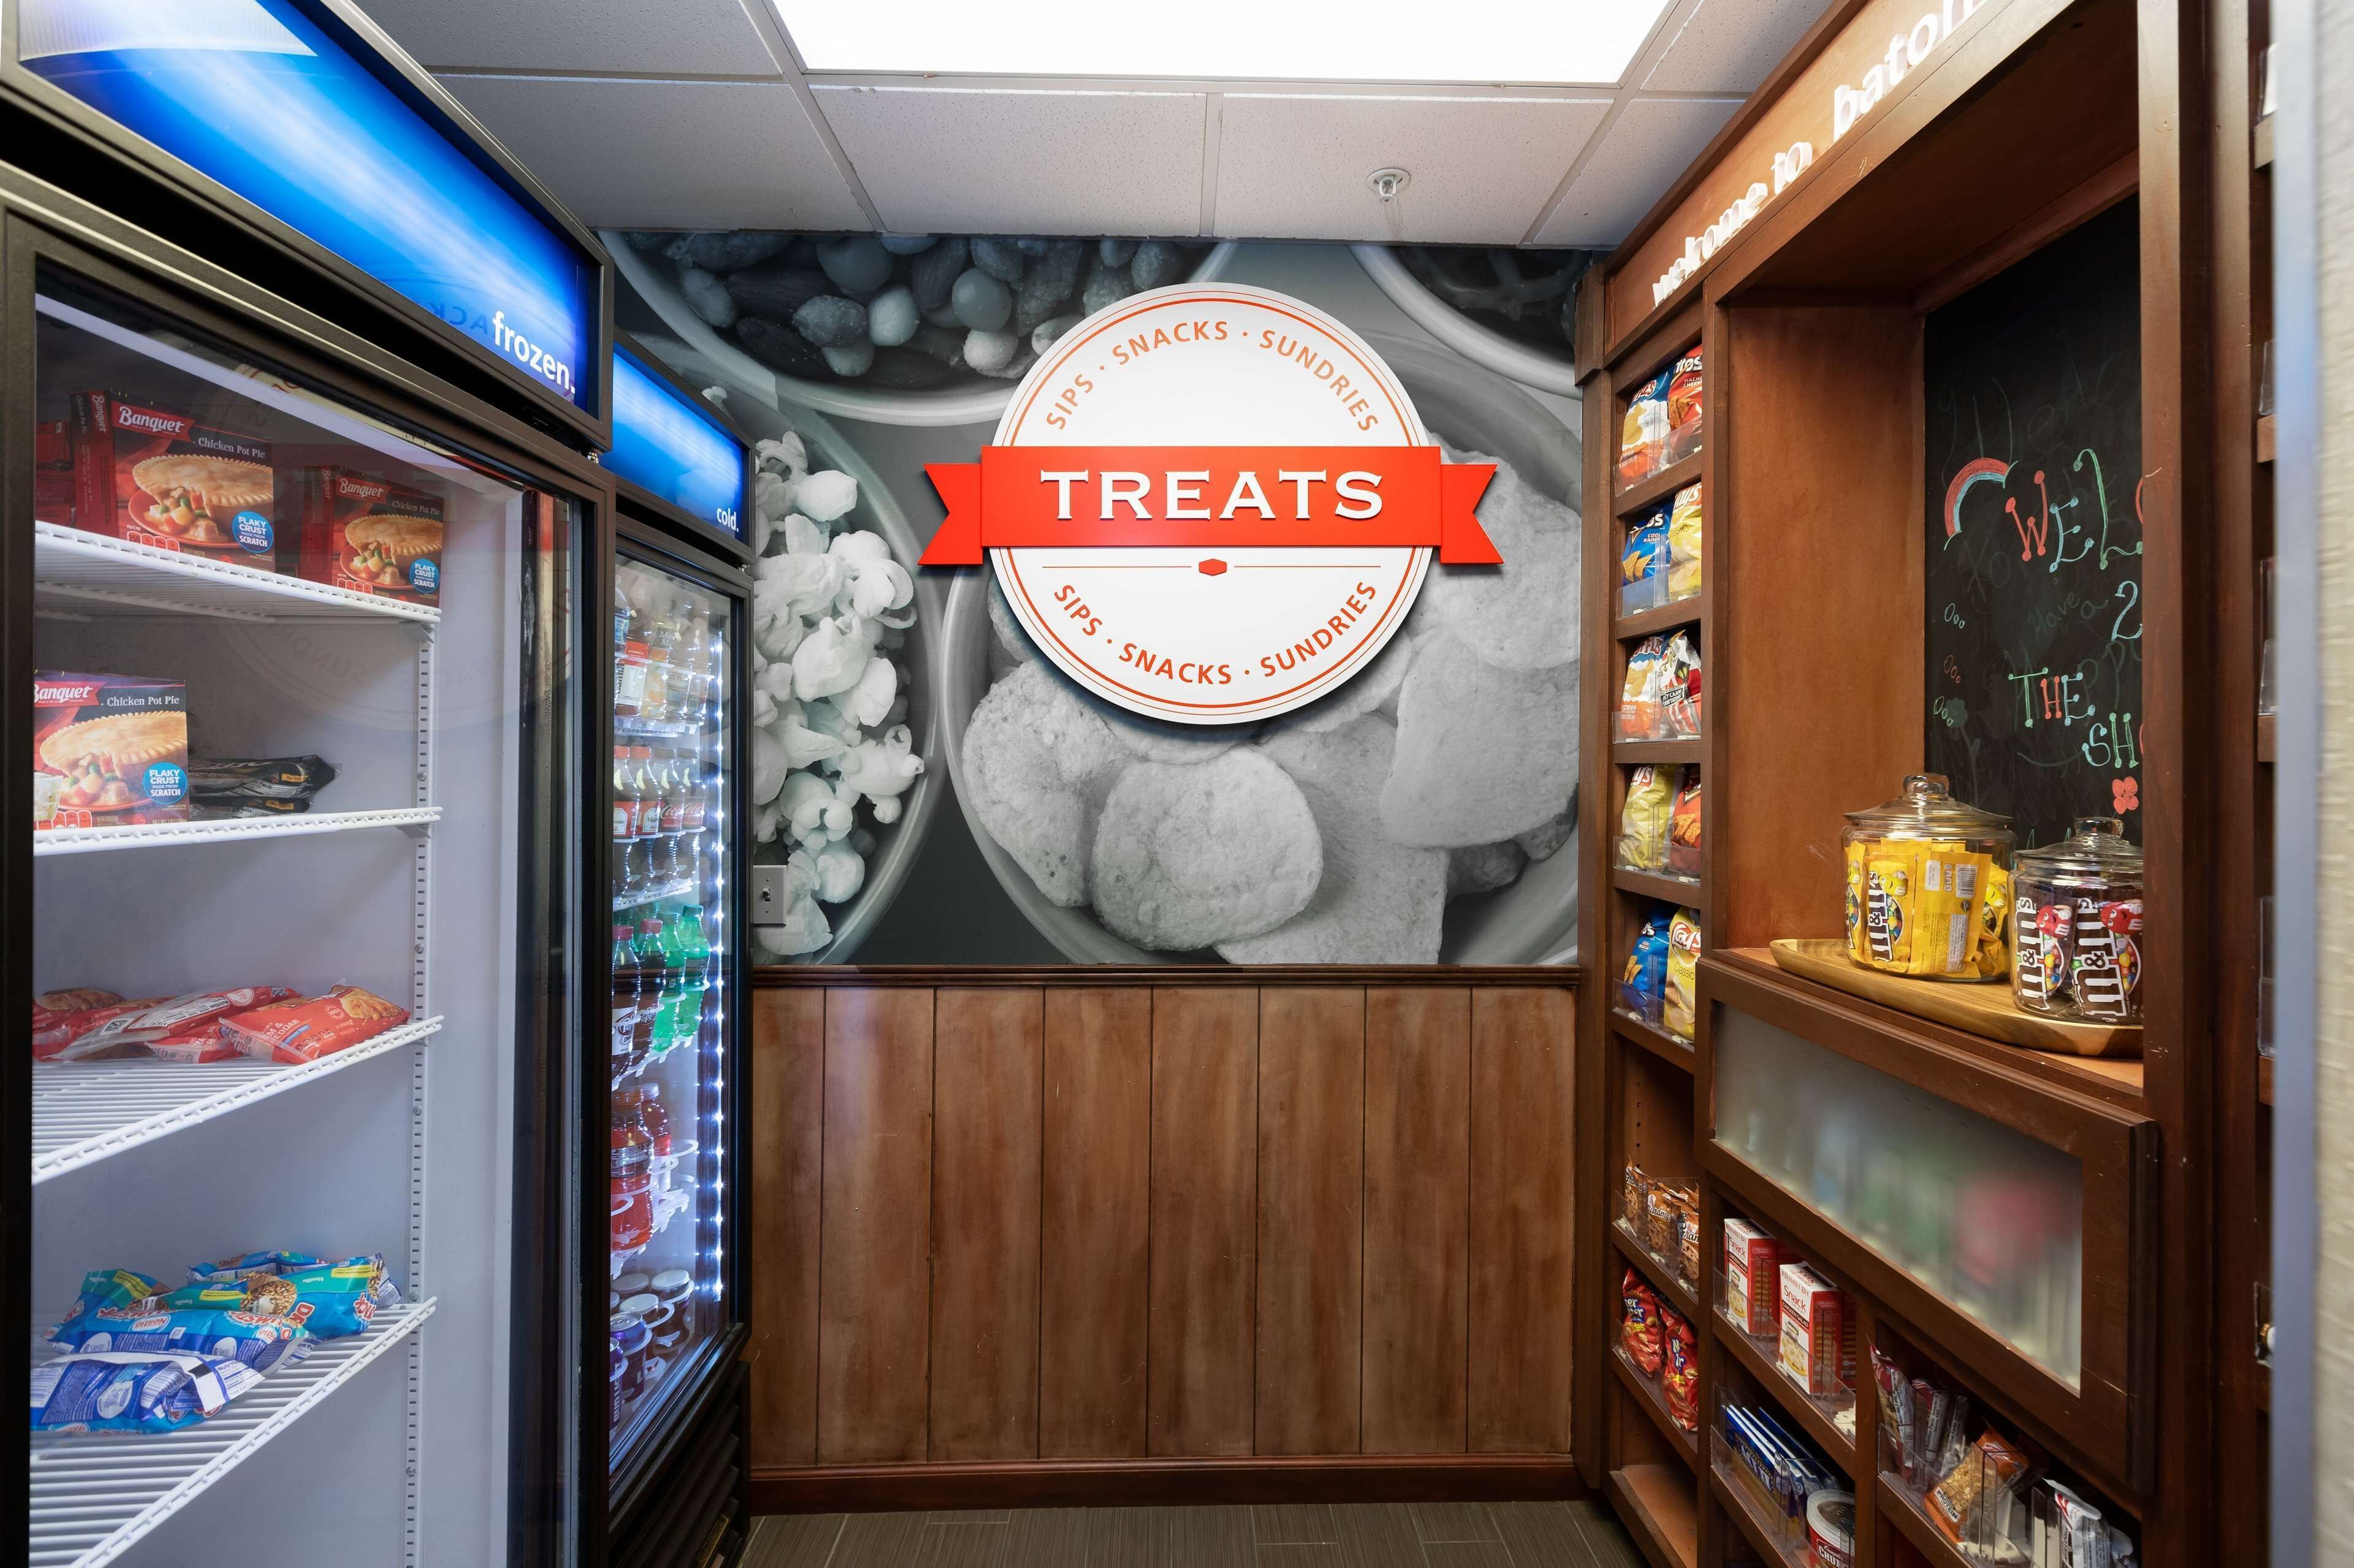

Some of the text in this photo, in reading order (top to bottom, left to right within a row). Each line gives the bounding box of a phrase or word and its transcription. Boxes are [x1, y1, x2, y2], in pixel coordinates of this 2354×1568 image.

[1771, 142, 1813, 195] to
[493, 311, 575, 394] frozen.
[1046, 321, 1379, 432] SIPS SNACKS SUNDRIES
[120, 406, 184, 433] Banquet
[198, 438, 265, 459] Chicken Pot Pie
[340, 478, 384, 497] Banquet
[1040, 469, 1383, 521] TREATS
[392, 500, 417, 512] Chicken
[238, 517, 266, 528] FLAKY
[717, 506, 739, 532] cold.
[238, 524, 266, 535] CRUST
[239, 535, 267, 547] SCRATCH
[414, 569, 435, 577] CRUST
[415, 563, 435, 573] FLAKY
[414, 579, 435, 588] SCRATCH
[1053, 581, 1377, 685] SIPS SNACKS SUNDRIES
[107, 696, 145, 706] Chicken
[165, 696, 180, 704] Pie
[2008, 667, 2096, 728] THE
[151, 788, 180, 797] SCRATCH
[1675, 962, 1695, 980] Classic
[274, 1019, 300, 1039] EDDAR
[1784, 1285, 1806, 1312] Snack
[1937, 1490, 1959, 1520] PROTEIN
